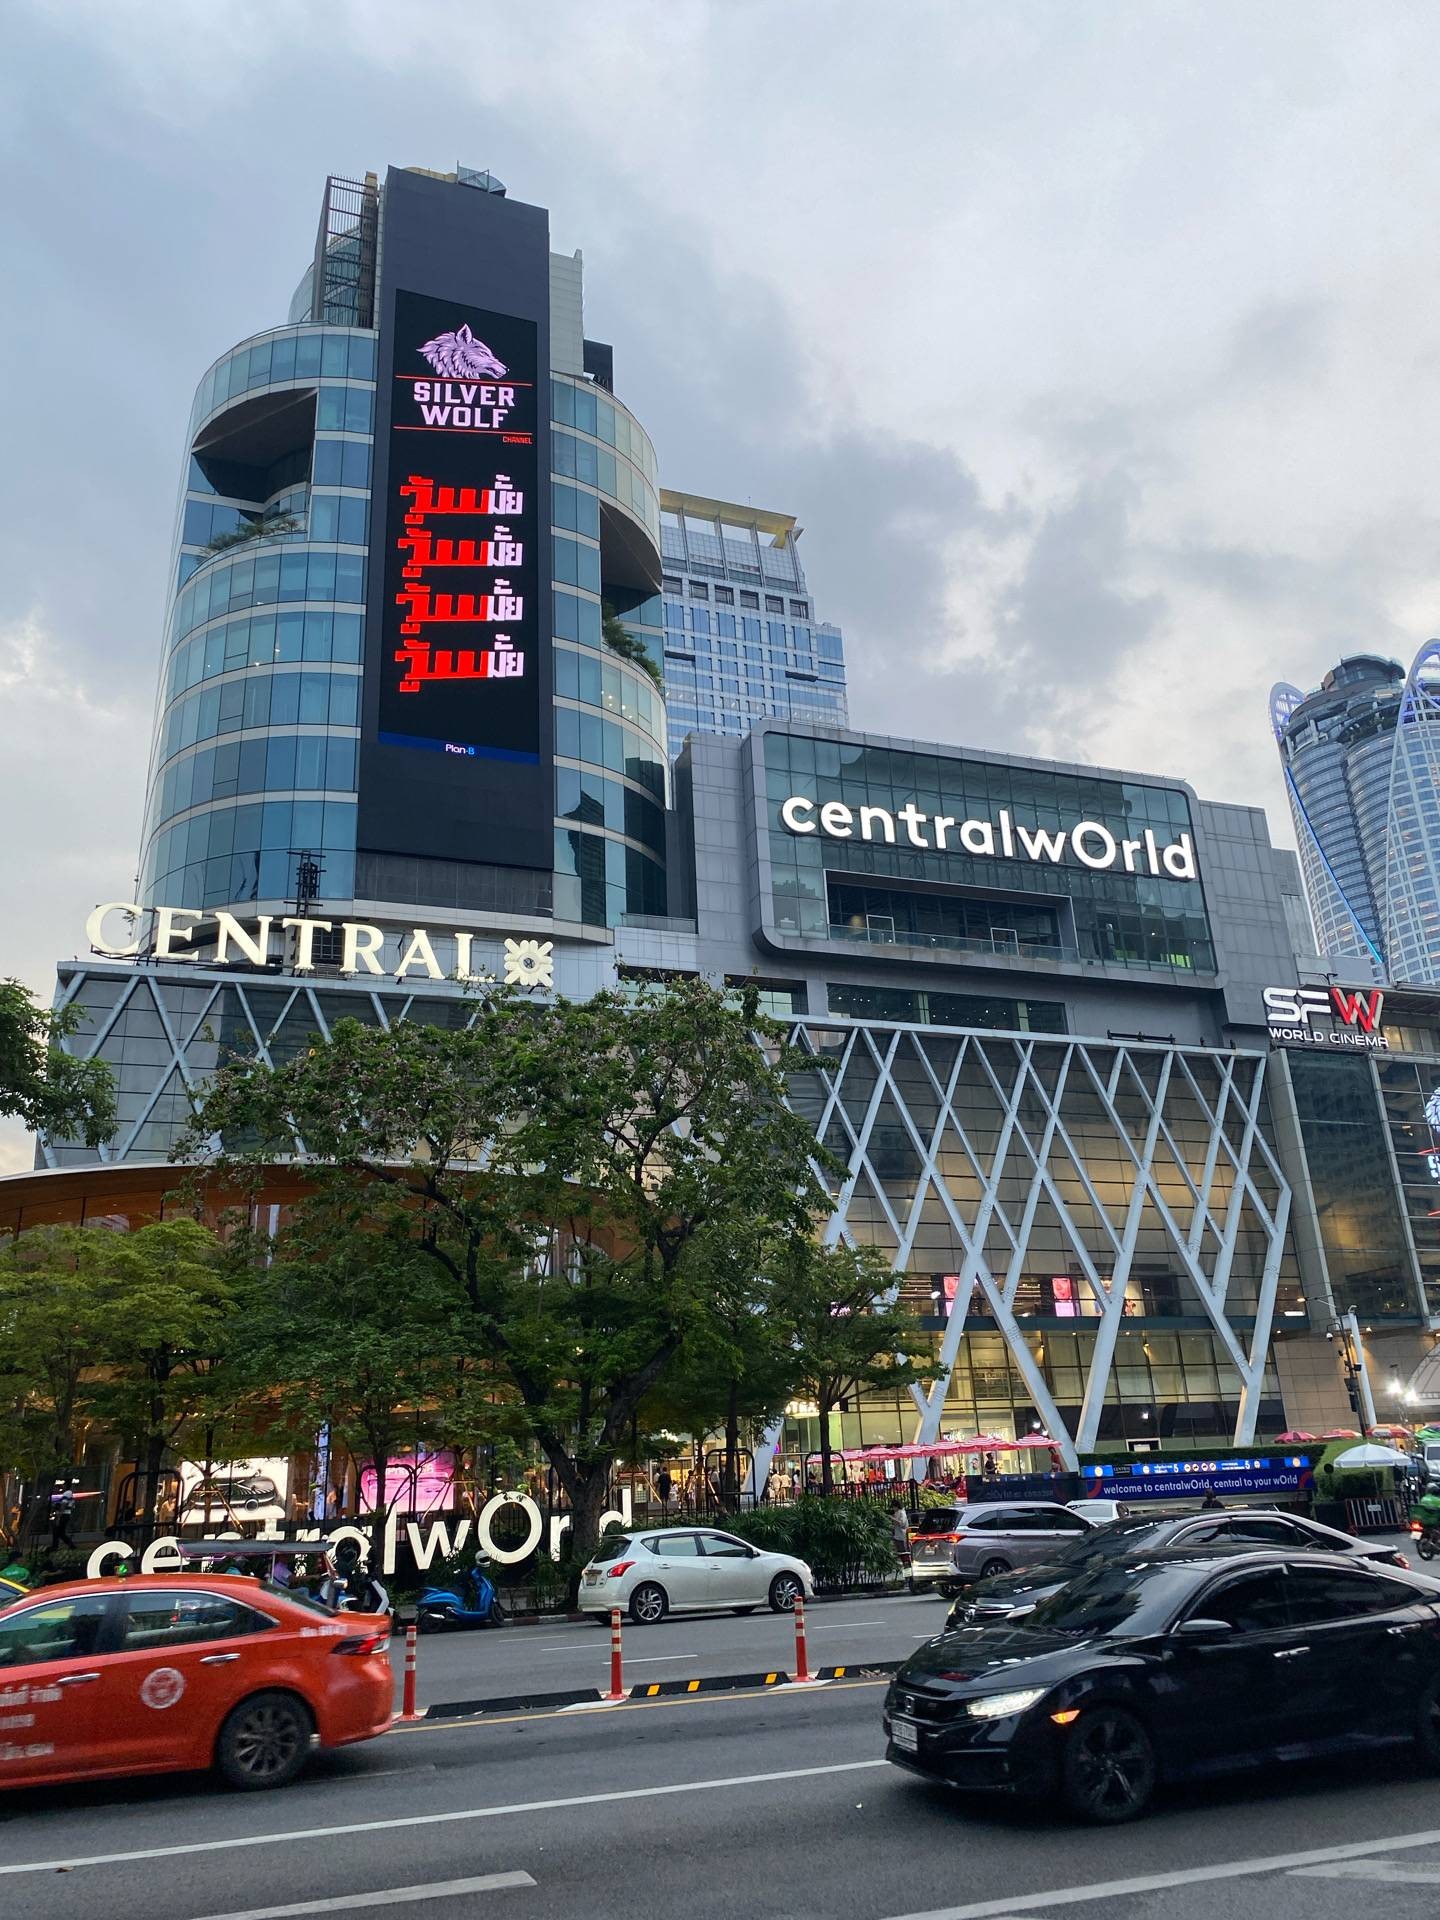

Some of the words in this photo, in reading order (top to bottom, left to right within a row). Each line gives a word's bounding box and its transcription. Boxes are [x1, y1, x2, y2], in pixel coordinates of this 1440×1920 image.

[413, 381, 515, 407] SILVER
[420, 404, 509, 429] WOLF
[502, 436, 533, 445] CHANNEL
[781, 796, 1197, 880] centralwOrld
[86, 902, 496, 983] CENTRAL
[1269, 1027, 1324, 1042] WORLD
[1329, 1032, 1390, 1048] CINEMA
[1103, 1484, 1142, 1494] welcome
[1143, 1484, 1153, 1492] to
[1213, 1477, 1242, 1488] central
[1243, 1477, 1252, 1486] to
[1254, 1478, 1272, 1488] your
